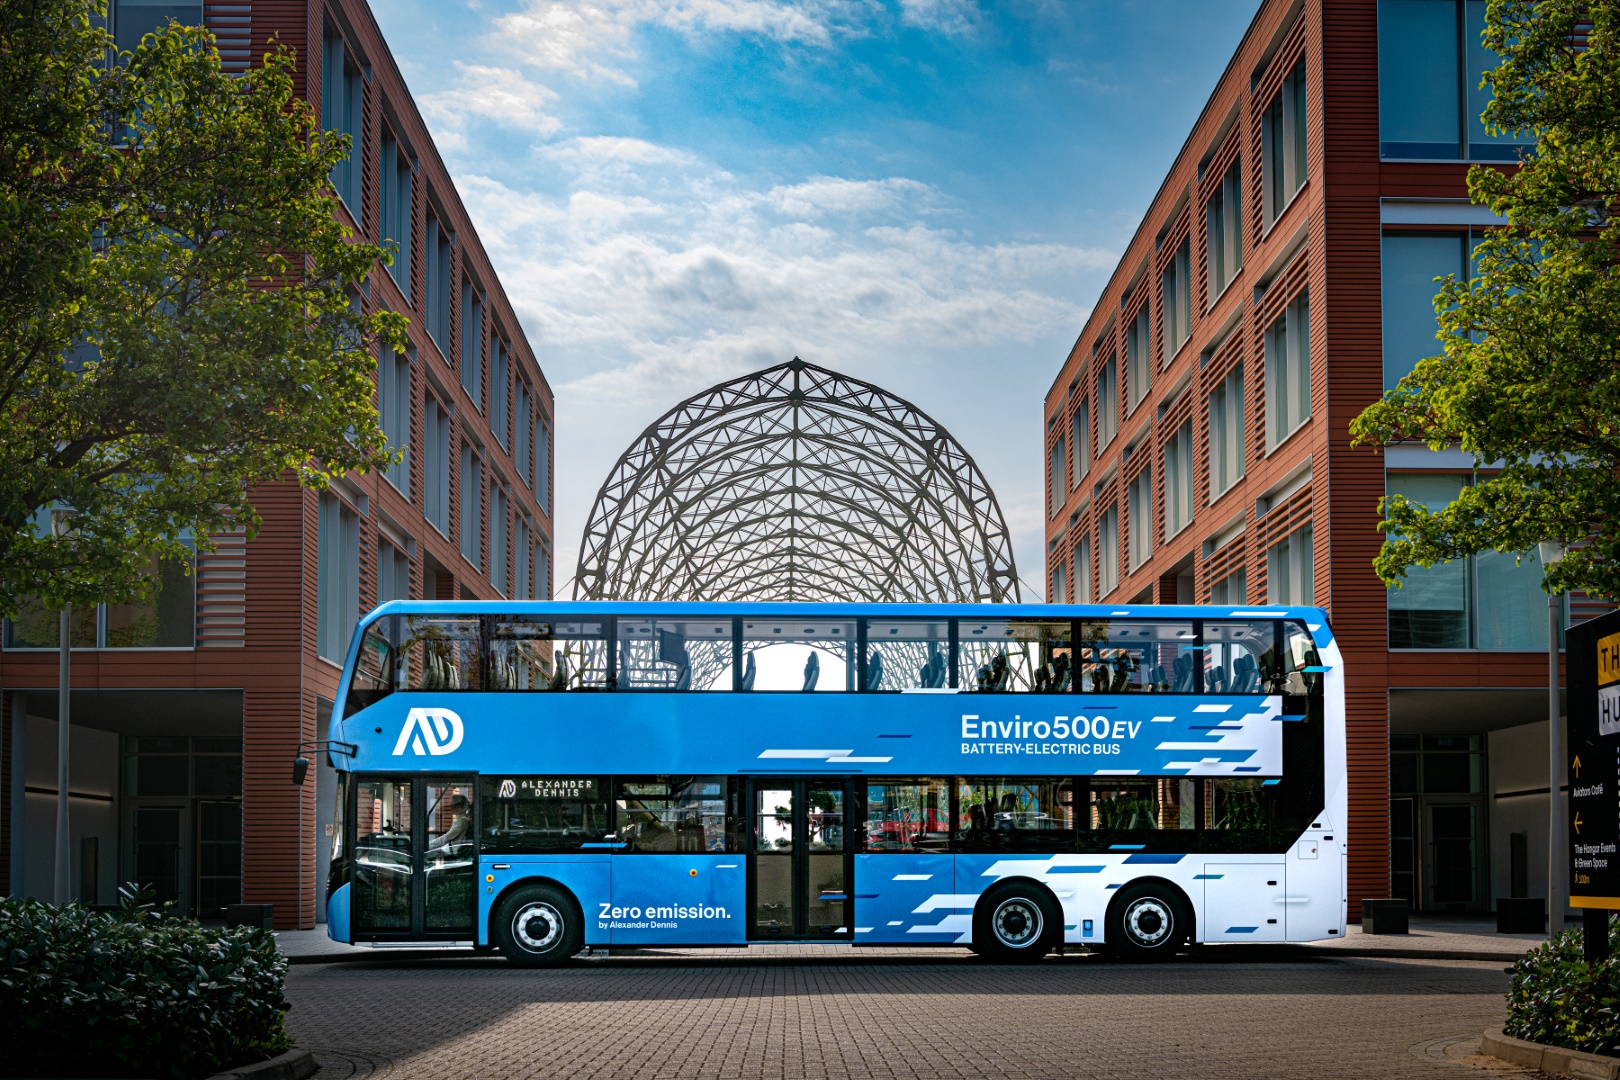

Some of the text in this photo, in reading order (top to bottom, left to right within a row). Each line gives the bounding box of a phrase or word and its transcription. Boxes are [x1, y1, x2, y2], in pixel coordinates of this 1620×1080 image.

[961, 743, 1121, 755] BATTERY-ELECTRIC BUS
[521, 780, 592, 789] ALEXANDER
[1573, 783, 1604, 797] Aviators Café
[534, 788, 580, 797] DENNIS
[1574, 843, 1616, 856] The Hangar Events
[1578, 858, 1592, 868] Green
[1592, 857, 1608, 869] Space
[598, 903, 731, 919] Zero emission.
[598, 921, 678, 930] by Alexander Dennis
